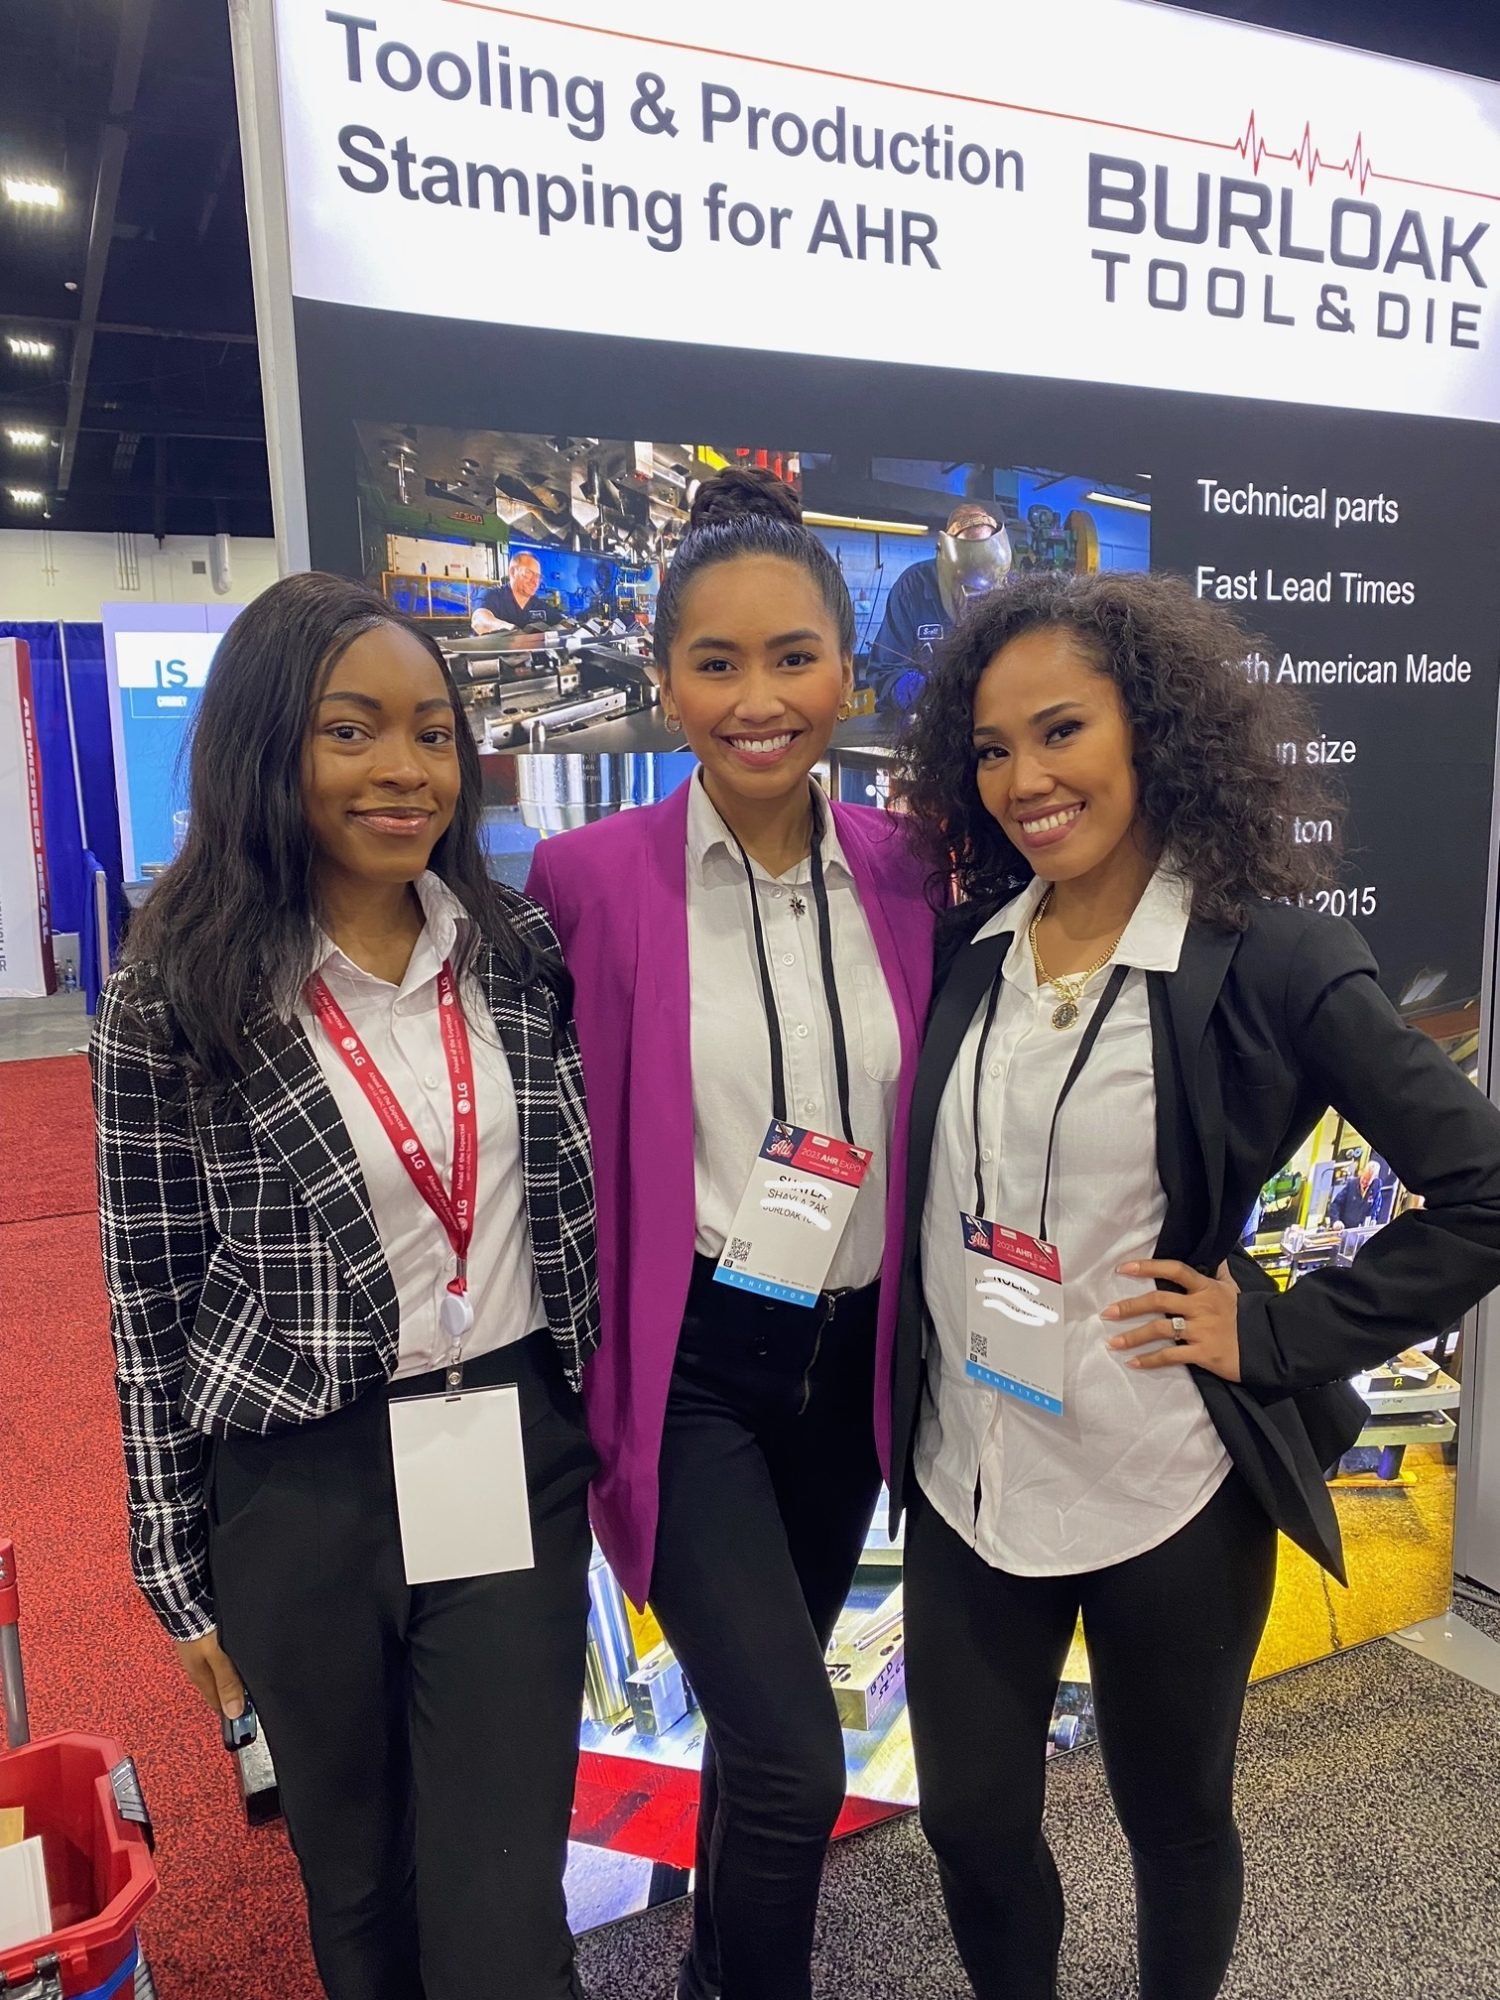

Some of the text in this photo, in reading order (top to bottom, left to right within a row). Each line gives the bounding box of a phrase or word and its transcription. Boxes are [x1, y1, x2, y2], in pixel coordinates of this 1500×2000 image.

[325, 9, 1024, 192] Tooling & Production
[337, 124, 942, 270] Stamping for AHR
[1087, 152, 1491, 289] BURLOAK
[1091, 248, 1482, 350] TOOL & DIE
[1197, 479, 1399, 529] Technical parts
[1197, 566, 1415, 605] Fast Lead Times
[1275, 653, 1397, 684] American
[1406, 653, 1472, 683] Made
[1305, 733, 1357, 764] size
[22, 696, 49, 945] ARMORED DECAL
[1293, 816, 1333, 843] ton
[350, 1050, 367, 1067] LG
[456, 1082, 469, 1098] LG
[410, 1153, 425, 1170] LG
[801, 1147, 821, 1160] 2023
[820, 1154, 839, 1167] AHR
[839, 1160, 862, 1173] EXPO
[457, 1199, 468, 1216] LG
[1016, 1247, 1033, 1259] AHR
[729, 1273, 806, 1301] EXHIBITOR
